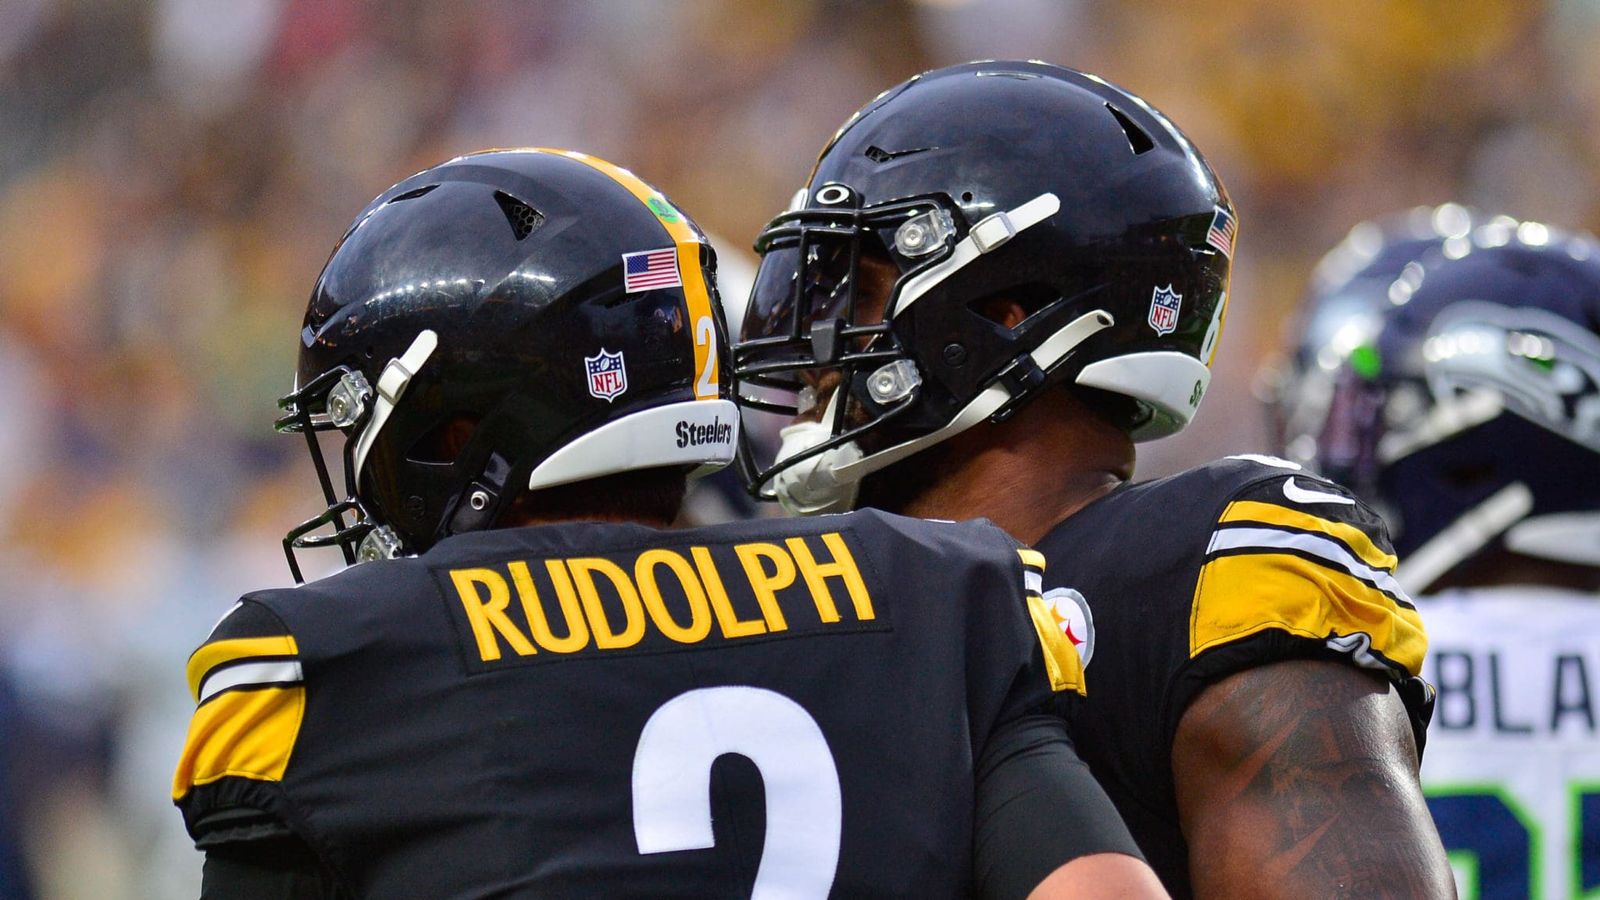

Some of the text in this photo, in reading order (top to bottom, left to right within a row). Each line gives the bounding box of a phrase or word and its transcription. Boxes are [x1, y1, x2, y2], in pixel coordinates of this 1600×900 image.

[1153, 305, 1175, 328] NFL
[1200, 291, 1226, 366] 6
[593, 371, 622, 393] NFL
[696, 316, 719, 396] 2
[675, 416, 732, 448] Steelers
[449, 532, 876, 662] RUDOLPH
[1432, 652, 1597, 734] BLA
[632, 685, 843, 900] 2
